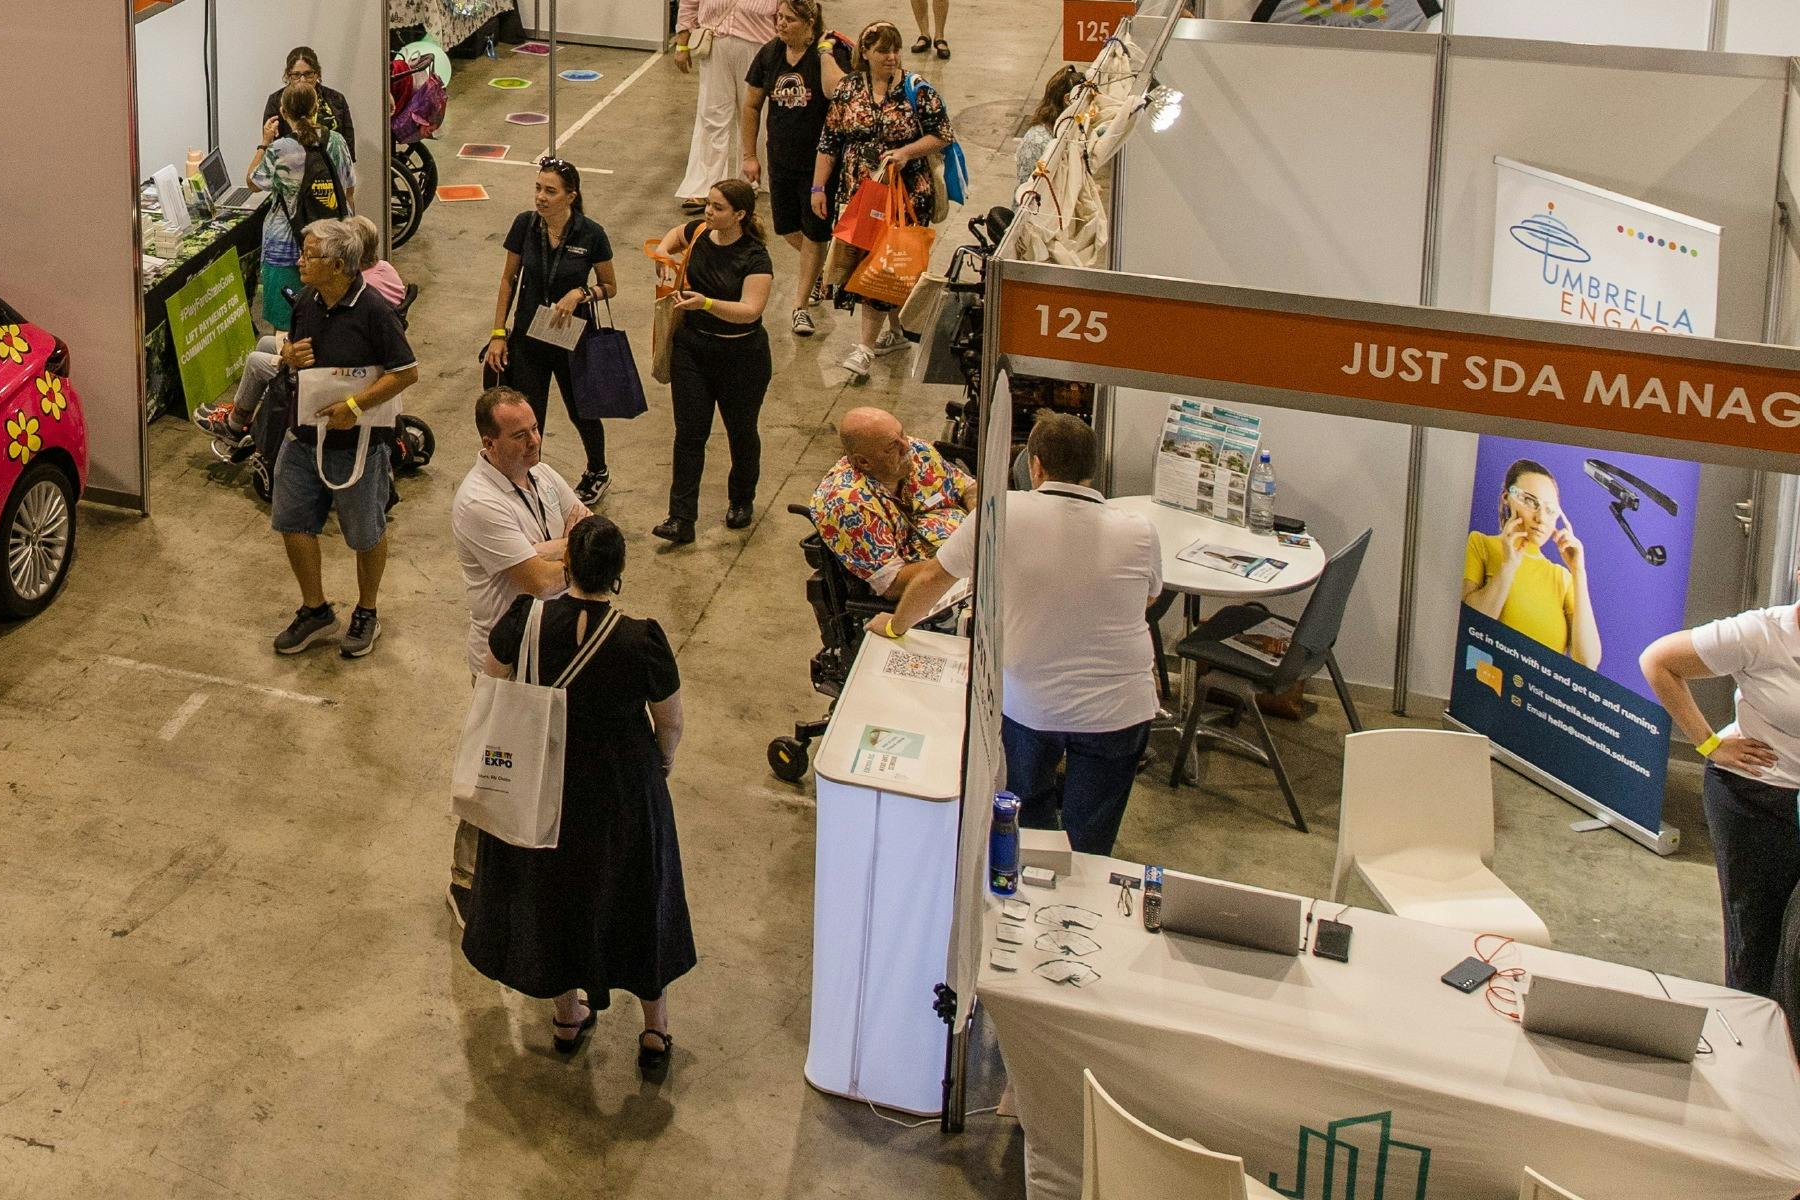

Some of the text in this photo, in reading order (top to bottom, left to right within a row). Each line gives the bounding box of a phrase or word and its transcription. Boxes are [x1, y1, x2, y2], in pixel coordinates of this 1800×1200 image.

[773, 86, 806, 97] GOOD
[185, 328, 198, 345] LIFT
[200, 308, 228, 334] PAYMENTS
[1543, 264, 1693, 333] UMBRELLA
[181, 302, 247, 365] COMMUNITY TRANSPORT
[1033, 304, 1109, 344] 125
[1341, 340, 1451, 386] JUST
[1462, 354, 1566, 402] SDA
[1468, 626, 1660, 735] Get in touch with us and get up and running.
[1528, 682, 1620, 739] Visit umbrella.solutions
[485, 757, 512, 768] EXPO
[1527, 703, 1650, 778] Email hello@umbrella.solutions
